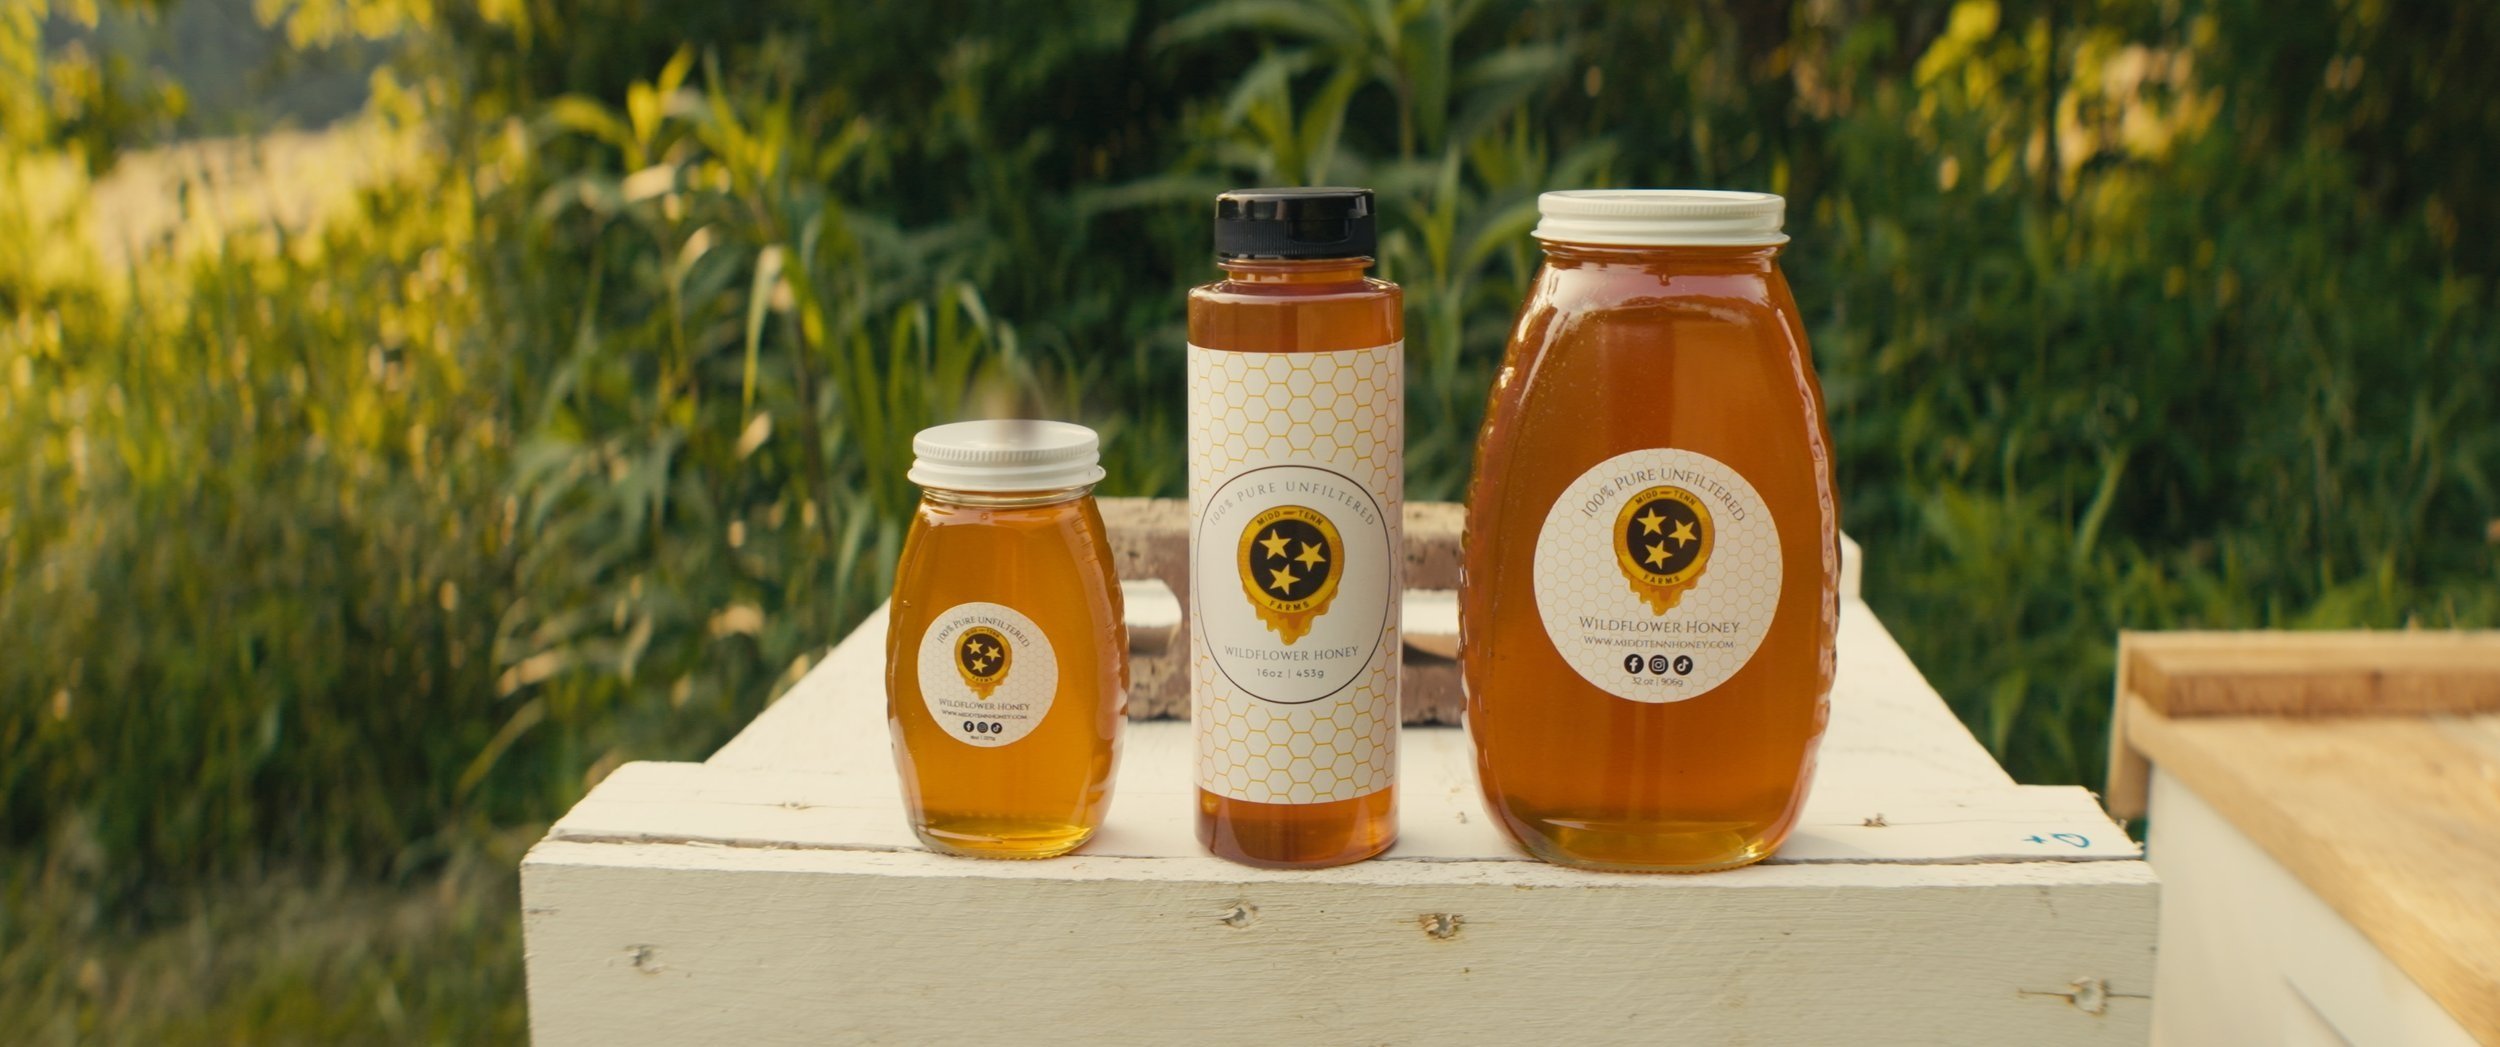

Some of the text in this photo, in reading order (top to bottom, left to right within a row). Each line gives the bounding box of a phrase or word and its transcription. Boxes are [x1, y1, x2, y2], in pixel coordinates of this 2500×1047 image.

[1237, 482, 1276, 501] PURE
[1286, 481, 1375, 526] UNFILTERED
[1582, 484, 1614, 518] 100%
[1635, 489, 1697, 506] MIDD TENN
[1256, 510, 1323, 526] MIDD TENN
[1643, 574, 1680, 584] FARMS
[1269, 600, 1310, 611] FARMS
[1224, 645, 1360, 661] WILDFLOWER HONEY
[1257, 668, 1282, 678] 16oz
[1296, 668, 1325, 678] 453g
